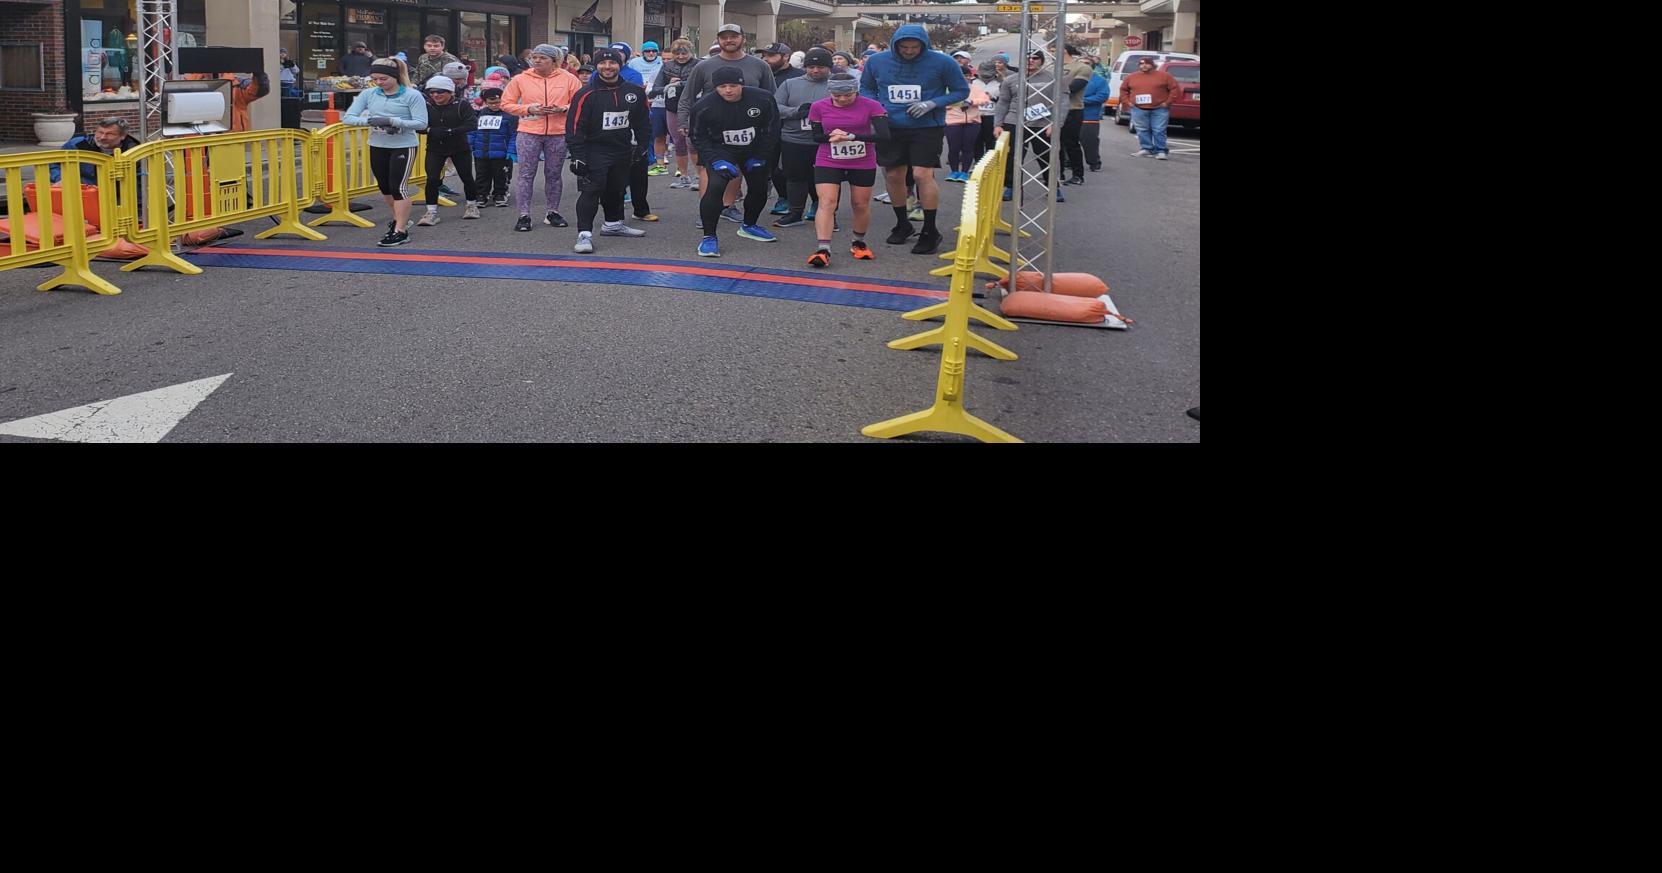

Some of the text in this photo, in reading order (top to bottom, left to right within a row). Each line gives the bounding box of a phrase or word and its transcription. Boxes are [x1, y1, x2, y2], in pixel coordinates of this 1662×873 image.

[890, 89, 920, 100] 1451
[478, 119, 500, 127] 1448
[604, 115, 628, 127] 1437
[725, 132, 754, 143] 1461
[832, 144, 865, 156] 1452
